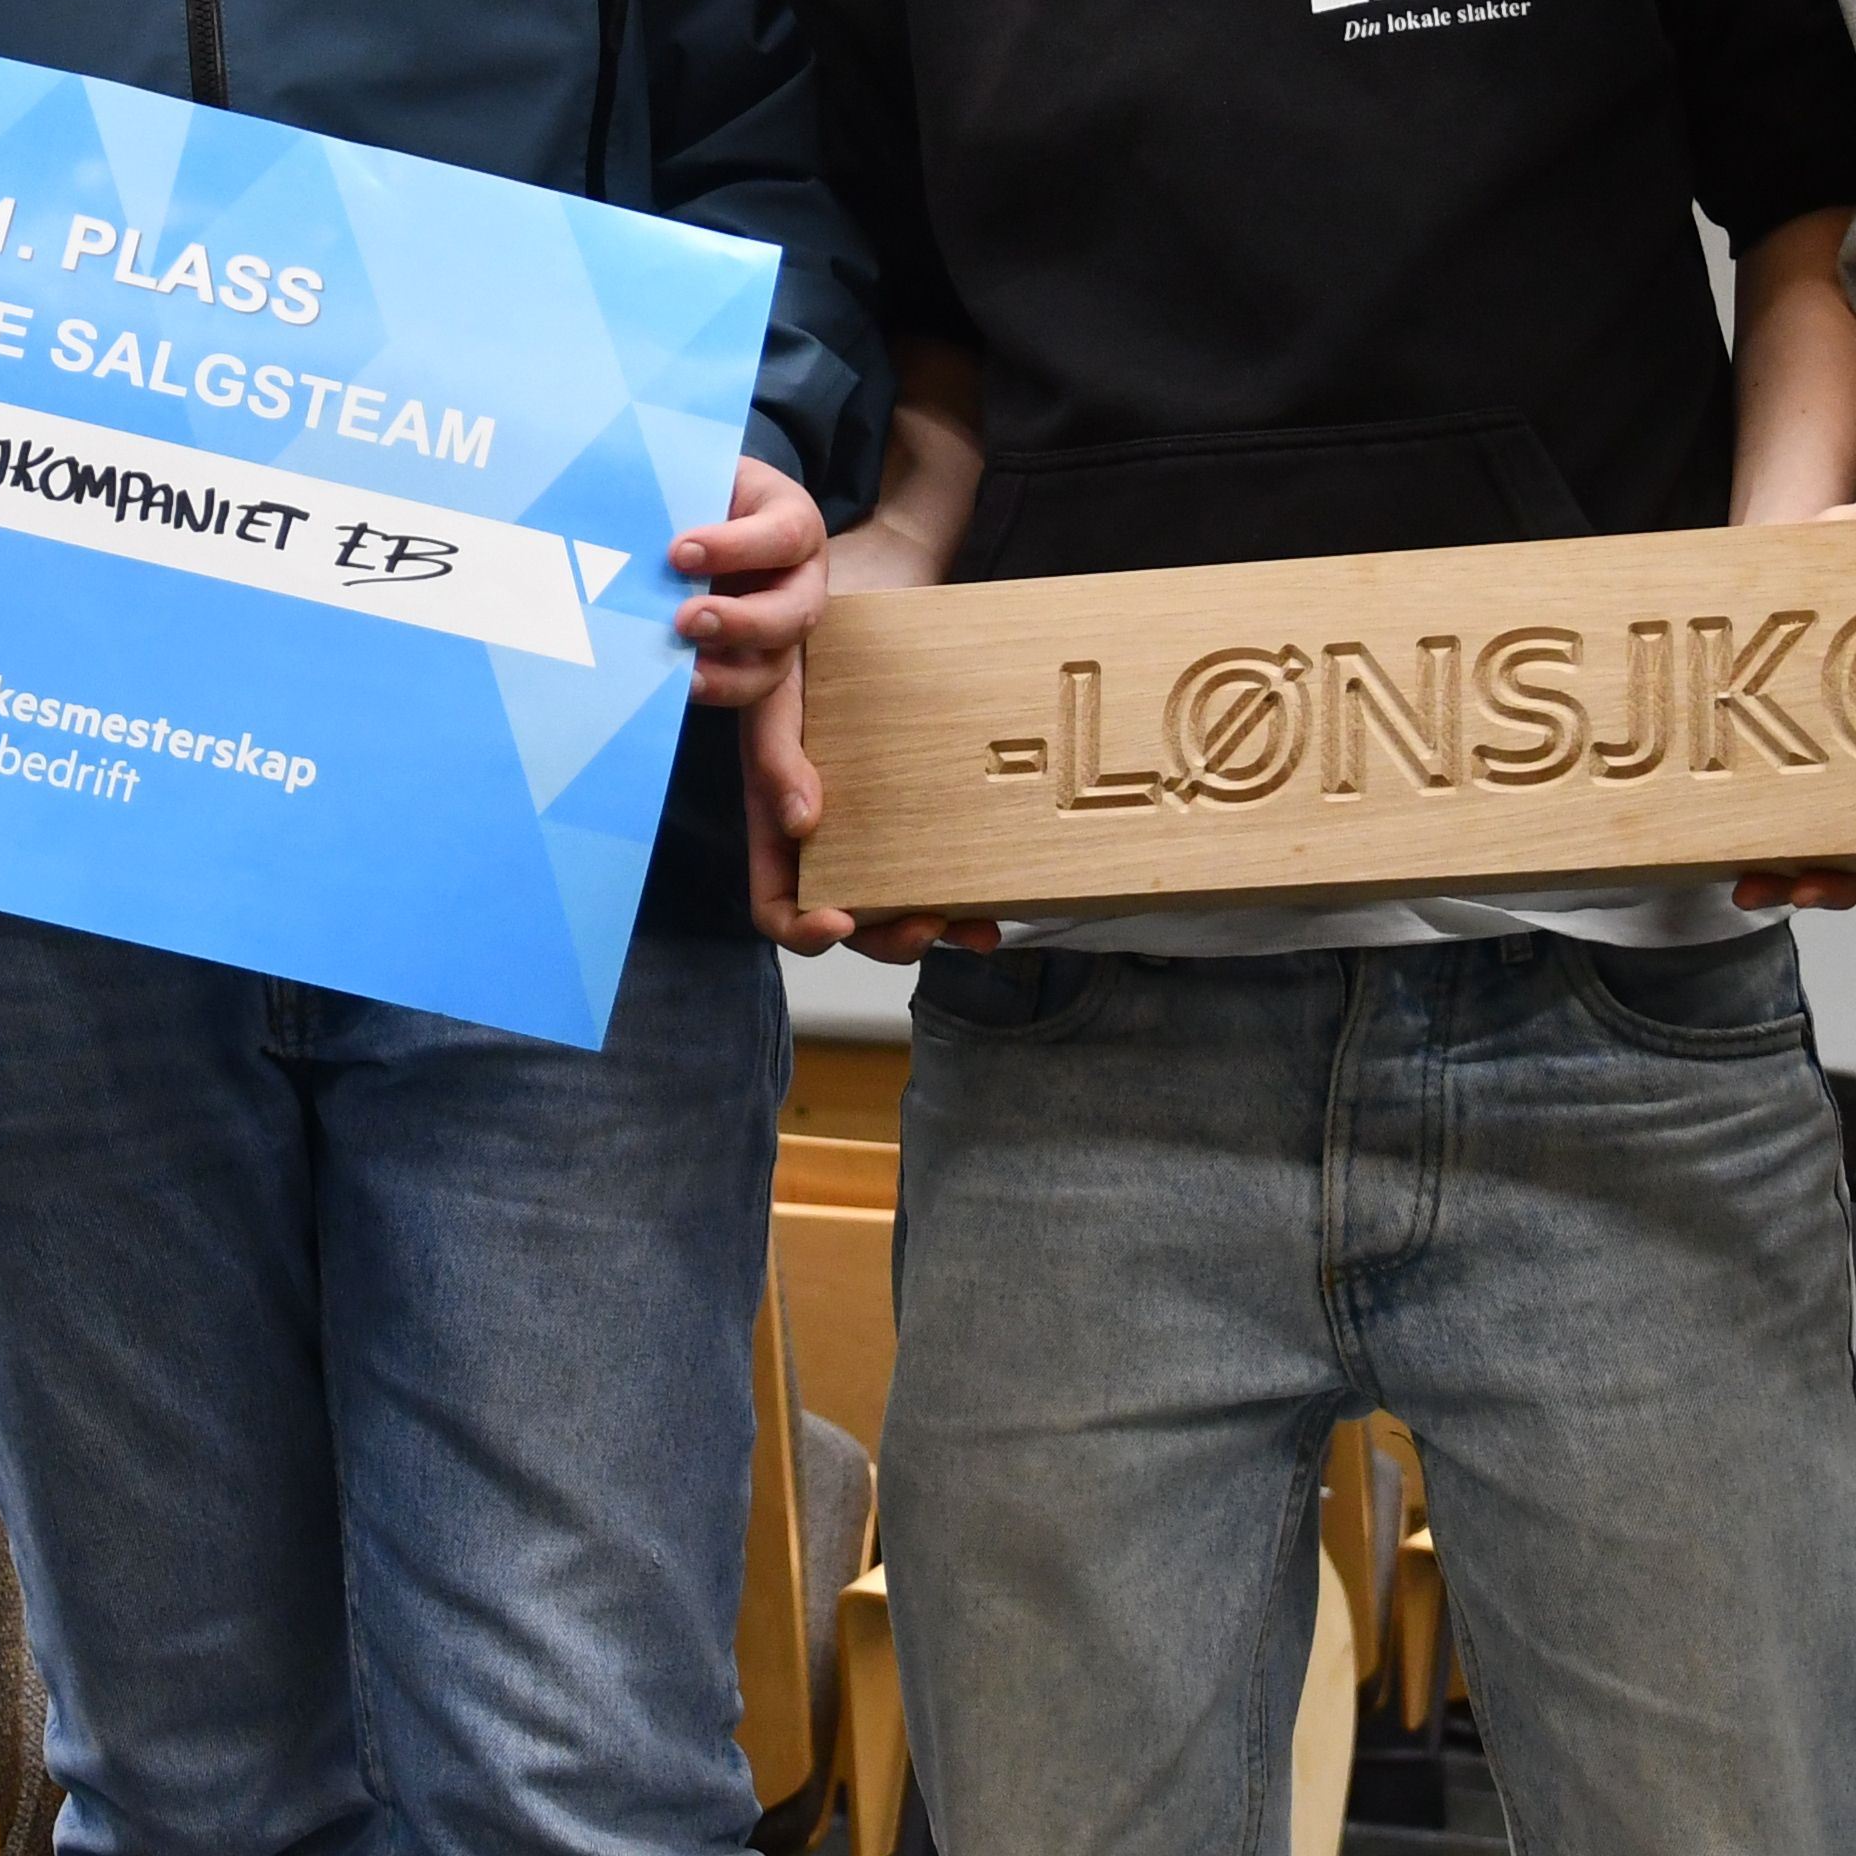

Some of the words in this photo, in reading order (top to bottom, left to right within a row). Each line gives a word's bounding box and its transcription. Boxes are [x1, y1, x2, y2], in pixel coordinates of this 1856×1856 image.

[1344, 18, 1381, 42] Din
[1387, 7, 1451, 33] lokale
[1457, 0, 1531, 24] slakter
[61, 213, 324, 326] PLASS
[49, 317, 496, 469] SALGSTEAM
[334, 522, 459, 587] EB
